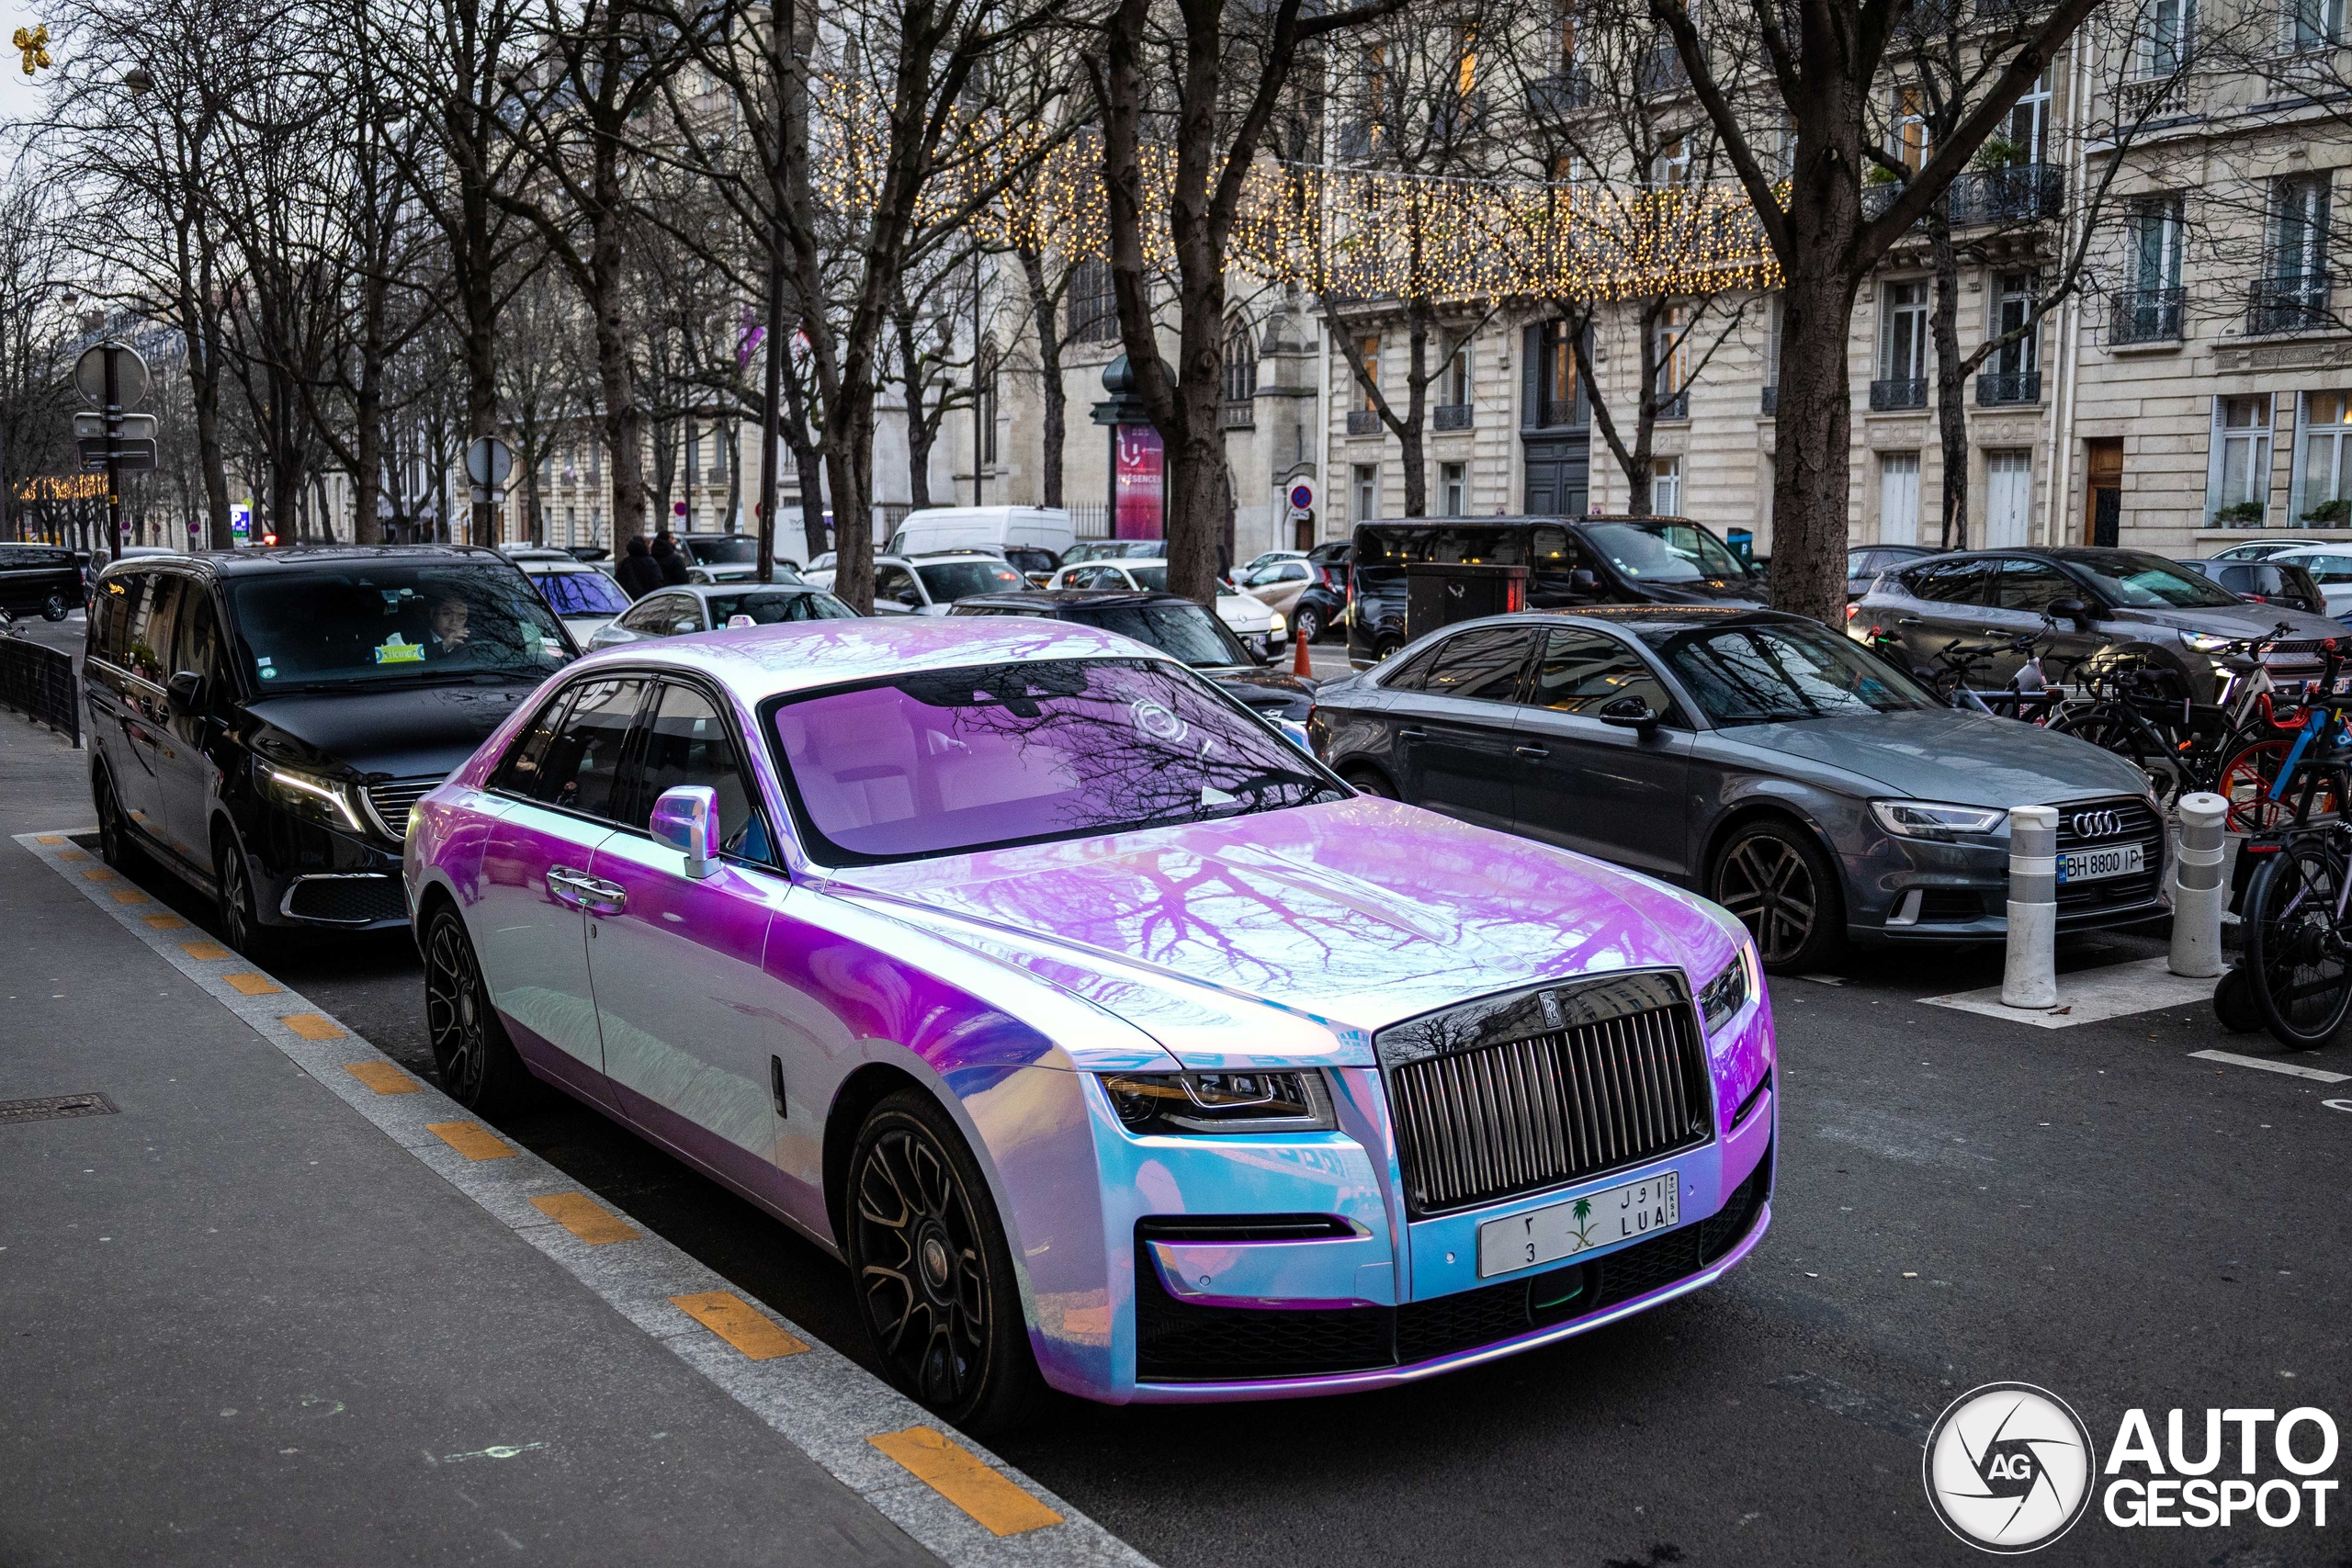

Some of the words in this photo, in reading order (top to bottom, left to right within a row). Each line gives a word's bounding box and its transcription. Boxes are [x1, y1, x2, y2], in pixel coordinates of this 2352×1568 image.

[2067, 856, 2087, 877] BH
[2090, 852, 2120, 874] 8800
[2125, 850, 2139, 870] IP
[1525, 1242, 1535, 1262] 3
[1622, 1206, 1664, 1236] LUA
